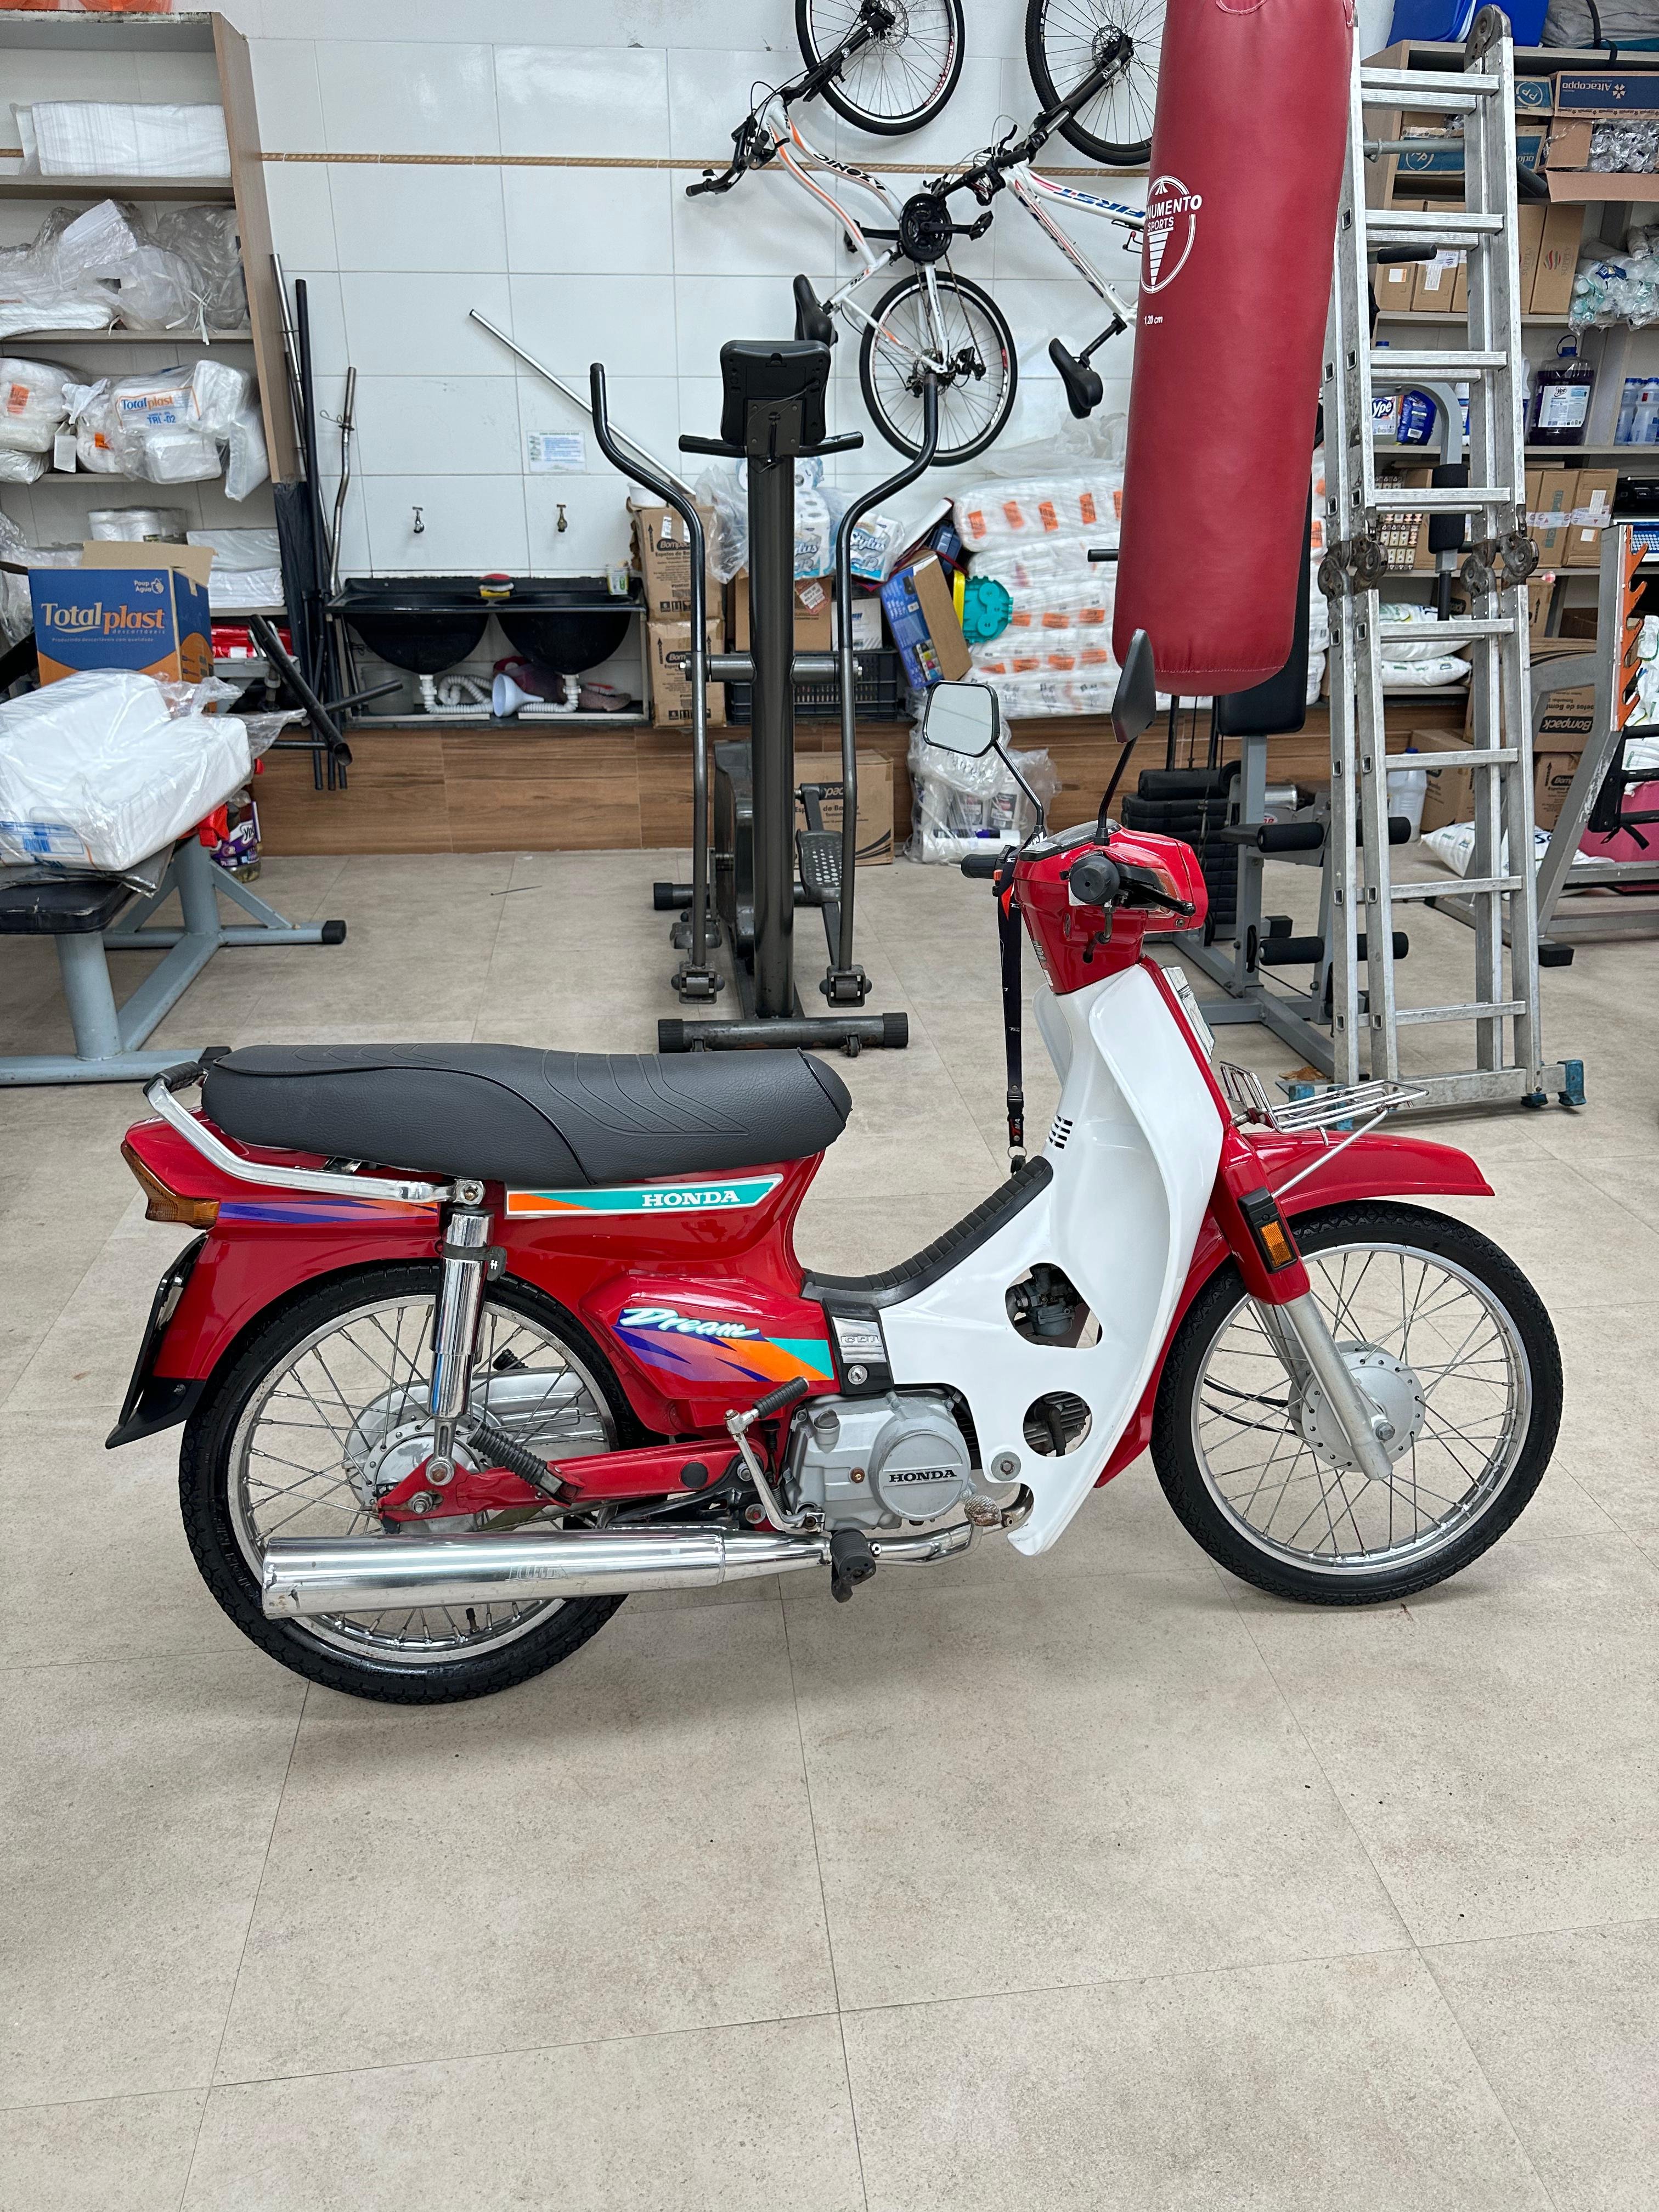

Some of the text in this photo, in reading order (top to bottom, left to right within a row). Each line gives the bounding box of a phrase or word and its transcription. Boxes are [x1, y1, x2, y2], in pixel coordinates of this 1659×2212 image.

[1562, 81, 1611, 91] Altacoppo
[813, 153, 886, 191] AZONIC
[1053, 188, 1146, 219] FIRST
[1147, 194, 1203, 219] NUMENTO
[1148, 216, 1174, 232] SPORTS
[41, 602, 165, 635] Totalplast
[1543, 718, 1593, 731] Bompack
[642, 1190, 741, 1207] HONDA
[620, 1307, 760, 1338] Dream
[845, 1335, 876, 1343] CDI
[889, 1469, 957, 1482] HONDA
